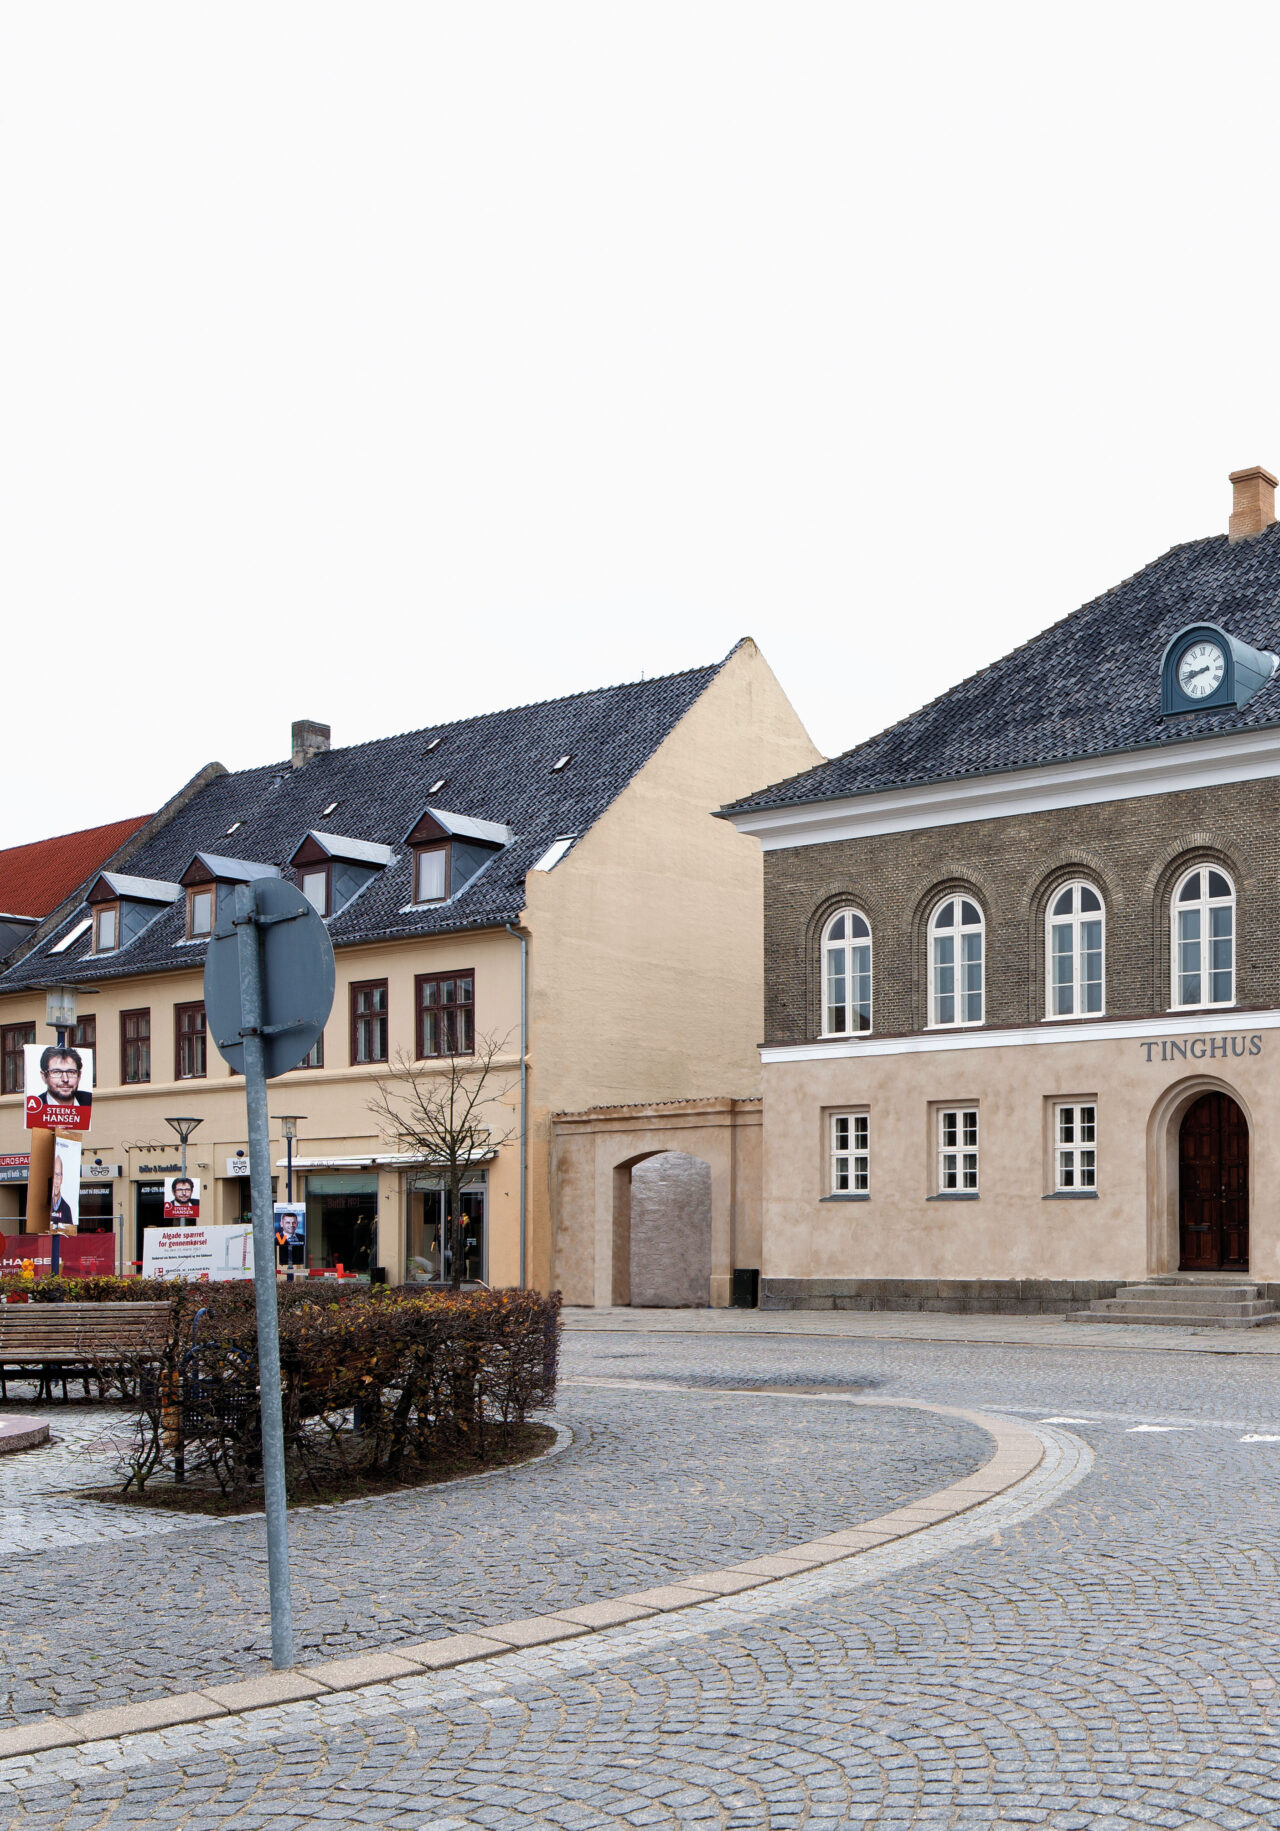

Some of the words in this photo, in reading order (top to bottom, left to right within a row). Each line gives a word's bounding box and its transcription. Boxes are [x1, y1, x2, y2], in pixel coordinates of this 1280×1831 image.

[1140, 1034, 1263, 1062] TINGHUS
[27, 1098, 37, 1108] A
[46, 1107, 71, 1115] STEEN
[42, 1113, 80, 1123] HANSEN
[162, 1232, 182, 1240] Algade
[183, 1231, 205, 1239] spærret
[158, 1240, 167, 1248] for
[168, 1239, 208, 1249] gennemkørsel
